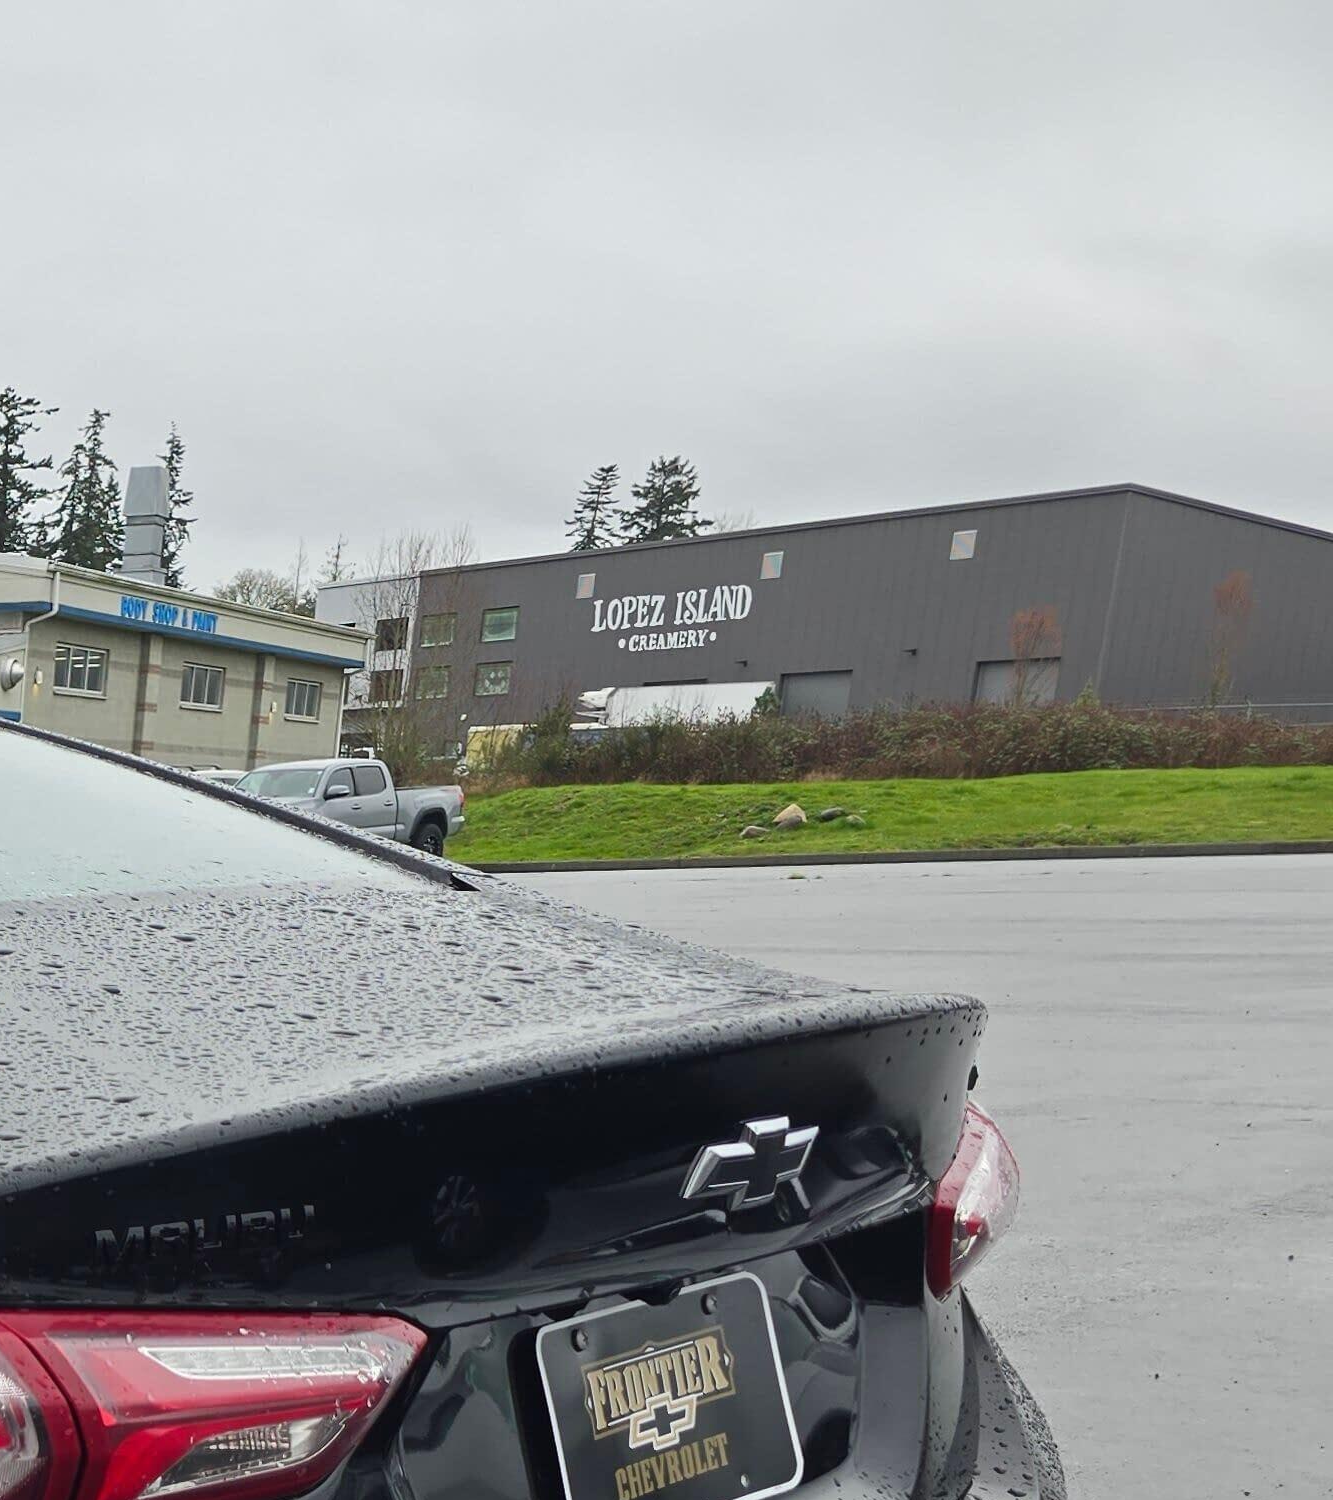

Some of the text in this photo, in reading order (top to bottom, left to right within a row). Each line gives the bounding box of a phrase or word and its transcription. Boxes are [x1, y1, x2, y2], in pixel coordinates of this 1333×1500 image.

[121, 596, 148, 620] BODY
[590, 585, 752, 632] LOPEZ ISLAND
[629, 629, 709, 651] CREAMERY
[587, 1336, 729, 1430] FRONTIER
